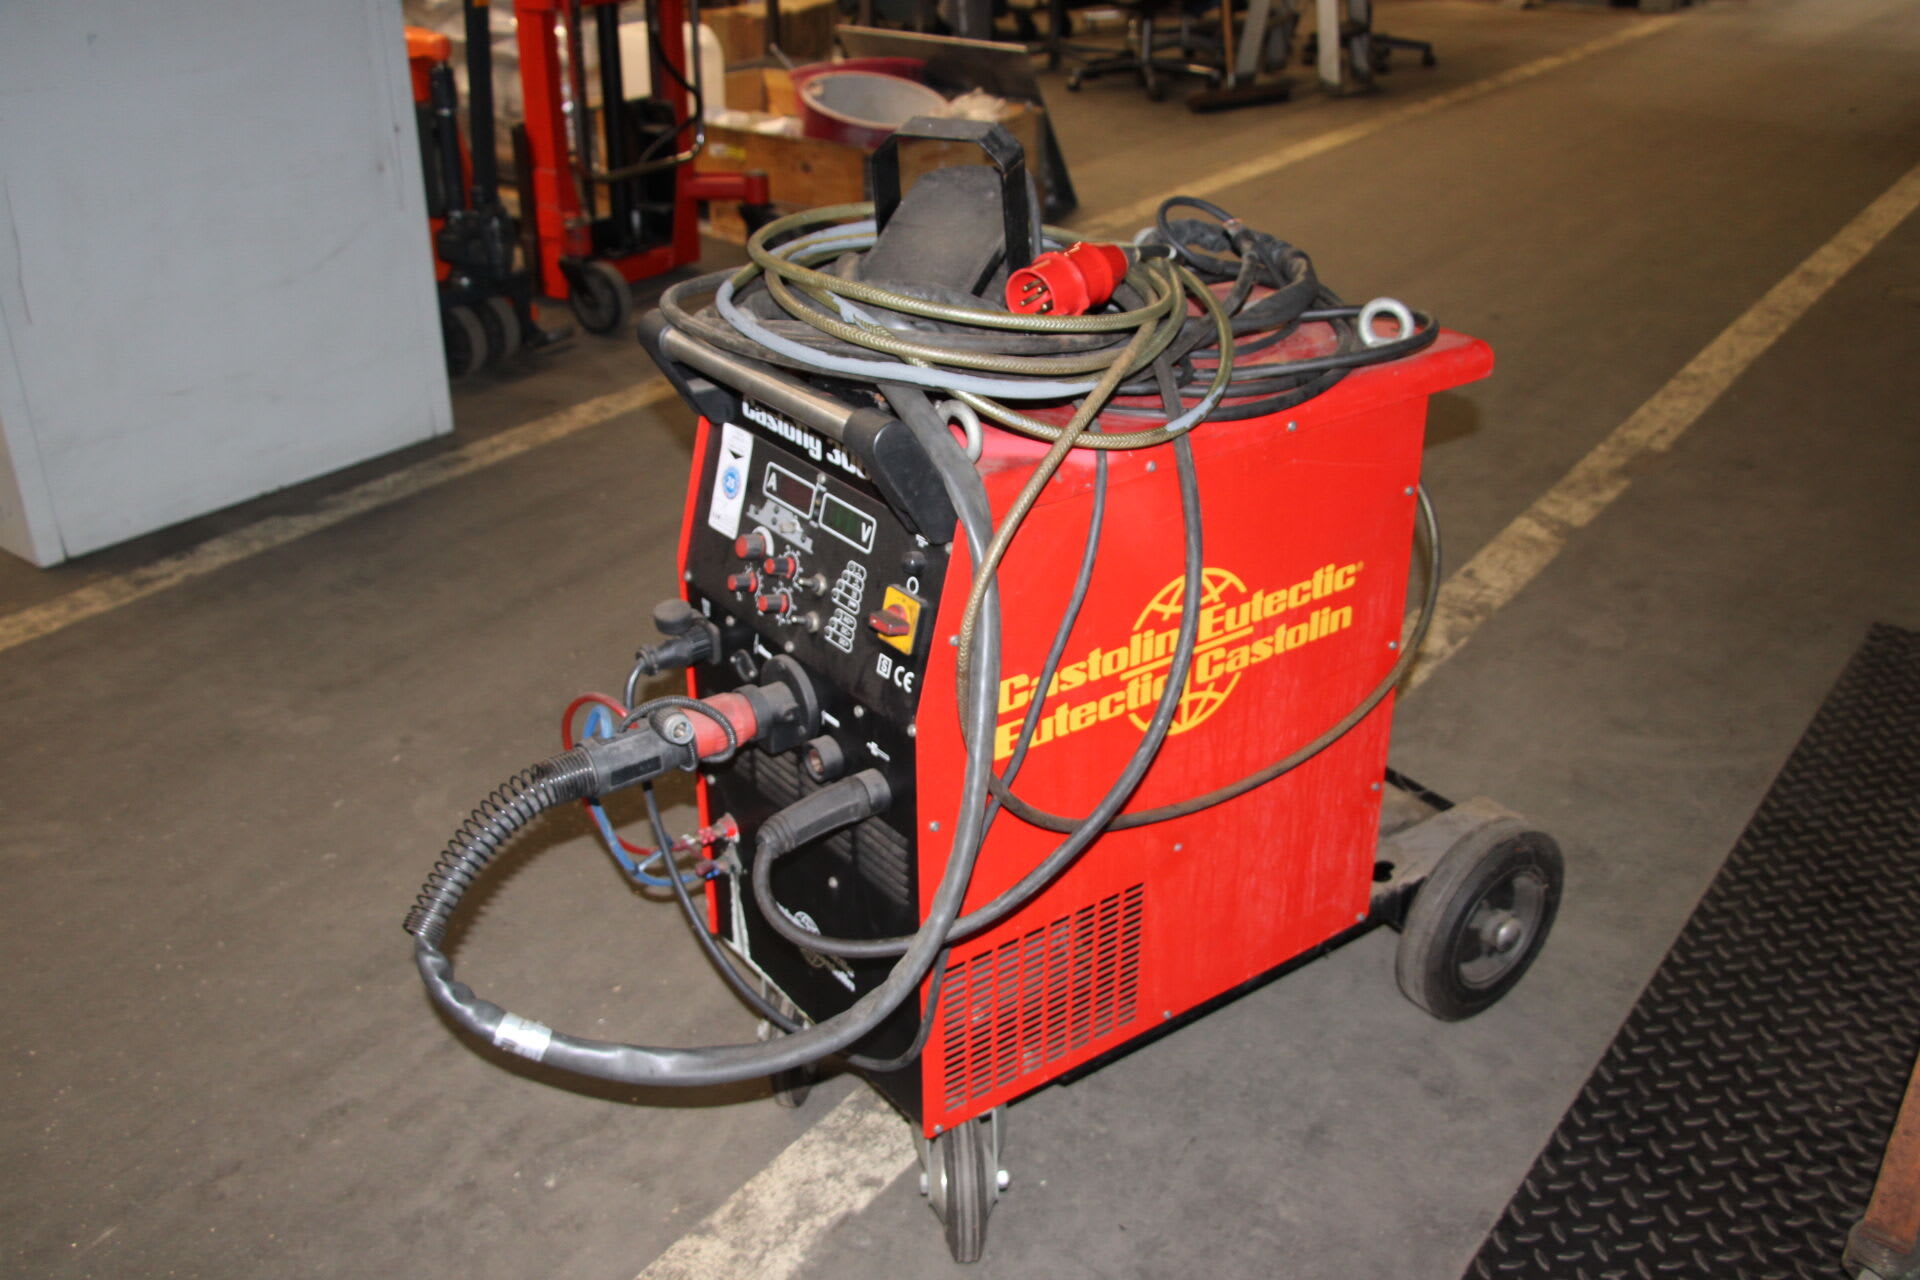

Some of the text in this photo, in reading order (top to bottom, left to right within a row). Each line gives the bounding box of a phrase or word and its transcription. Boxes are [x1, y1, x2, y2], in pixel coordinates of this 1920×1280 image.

[767, 474, 777, 491] A
[861, 522, 873, 543] V
[1198, 563, 1357, 642] Eutectic
[1195, 605, 1353, 684] Castolin
